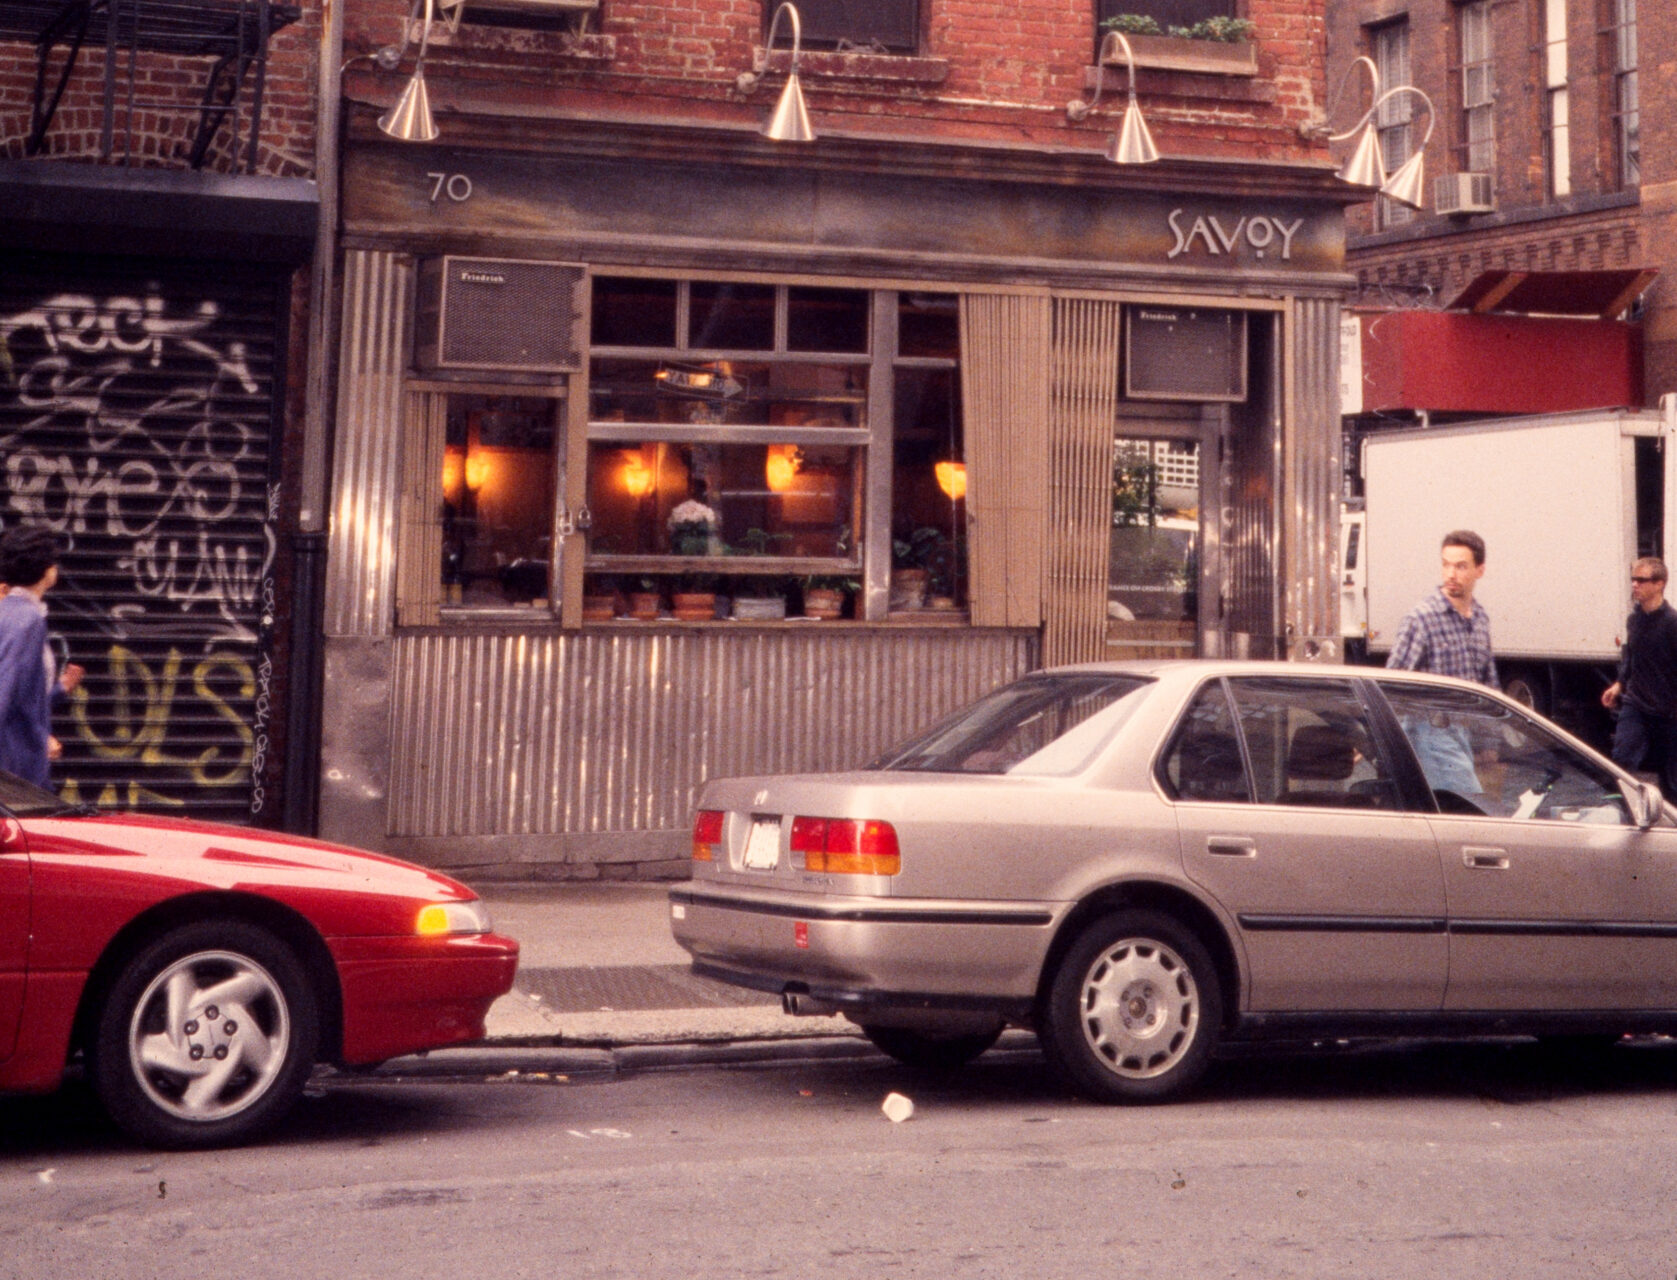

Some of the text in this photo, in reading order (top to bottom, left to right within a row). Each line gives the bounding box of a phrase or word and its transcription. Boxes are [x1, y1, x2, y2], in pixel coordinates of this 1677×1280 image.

[427, 172, 473, 202] 70
[1167, 208, 1303, 259] SAVOY
[461, 272, 504, 282] Friedrich
